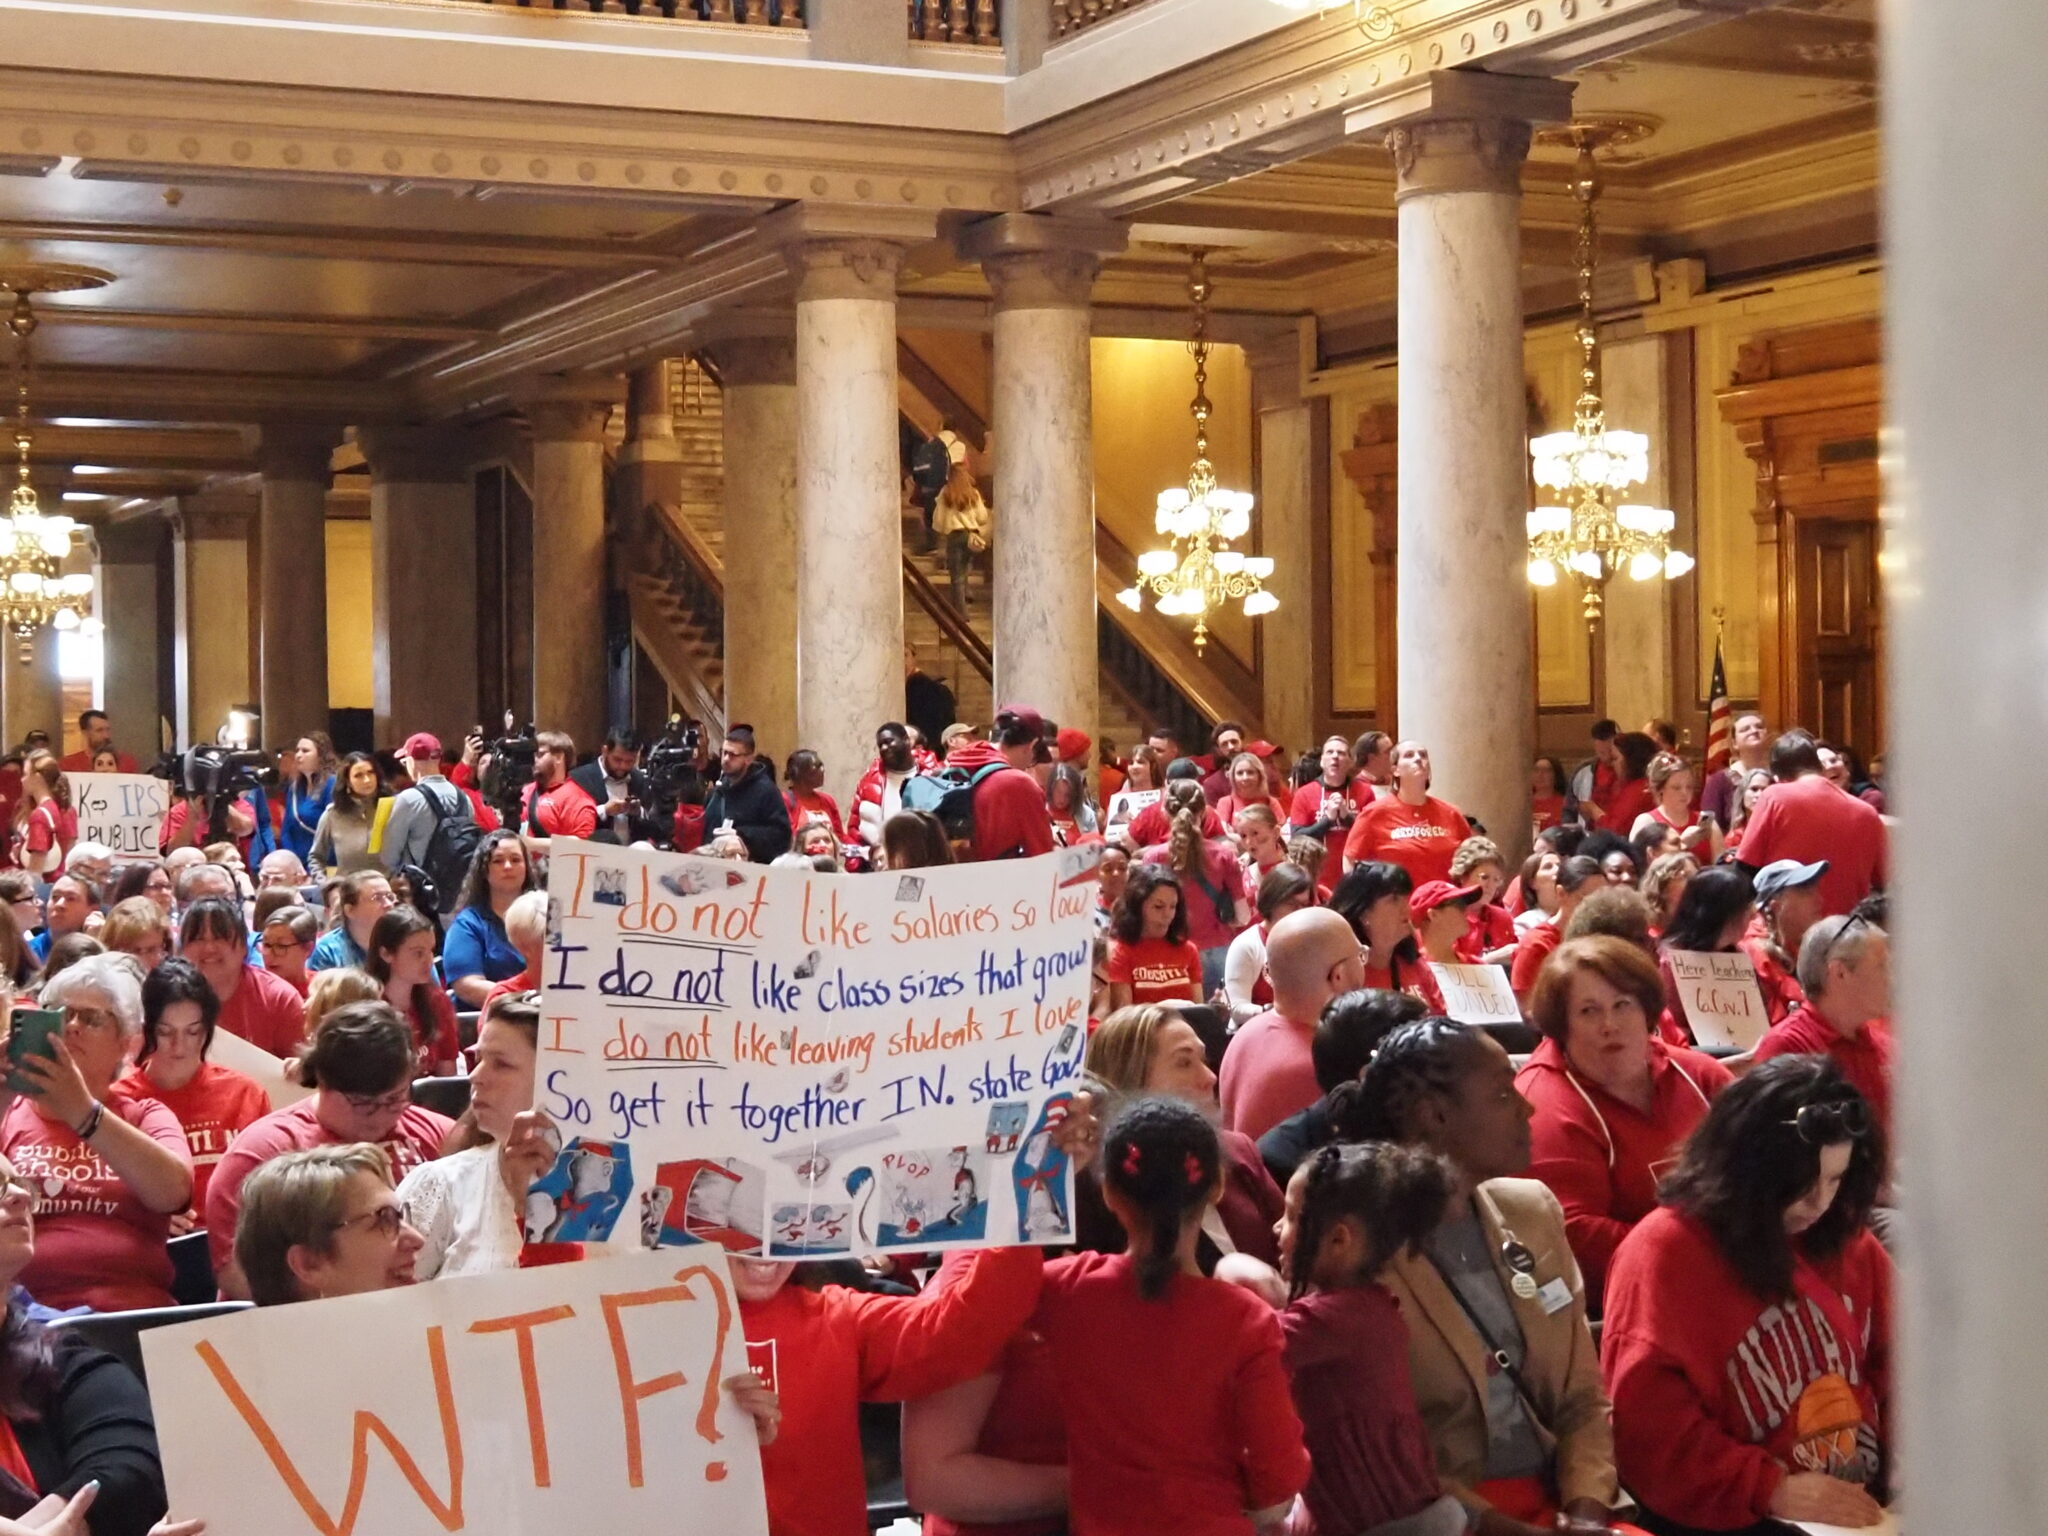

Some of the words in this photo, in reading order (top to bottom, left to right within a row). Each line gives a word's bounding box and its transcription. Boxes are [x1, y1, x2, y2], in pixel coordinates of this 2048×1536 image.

[119, 783, 160, 818] IPS
[88, 824, 156, 852] PUBLIC
[559, 853, 600, 919] I
[617, 864, 677, 934] do
[692, 875, 769, 941] not
[802, 880, 871, 949] like
[547, 945, 589, 990] I
[598, 947, 653, 997] do
[673, 948, 725, 1004] not
[752, 960, 802, 1013] like
[975, 948, 1029, 996] that
[544, 1016, 584, 1054] I
[604, 1017, 648, 1060] do
[665, 1014, 712, 1061] not
[734, 1021, 778, 1067] like
[790, 1025, 876, 1074] leaving
[888, 1006, 983, 1057] students
[995, 1008, 1024, 1041] I
[1034, 997, 1082, 1035] love
[544, 1069, 591, 1125] So
[610, 1081, 666, 1140] get
[687, 1077, 713, 1128] it
[731, 1081, 866, 1143] together
[880, 1064, 954, 1122] IN.
[969, 1054, 1033, 1104] state
[12, 1158, 120, 1182] chools
[16, 1141, 99, 1162] public
[882, 1153, 930, 1178] PLOP
[194, 1264, 732, 1536] WTF?
[1726, 1292, 1872, 1441] INDIA
